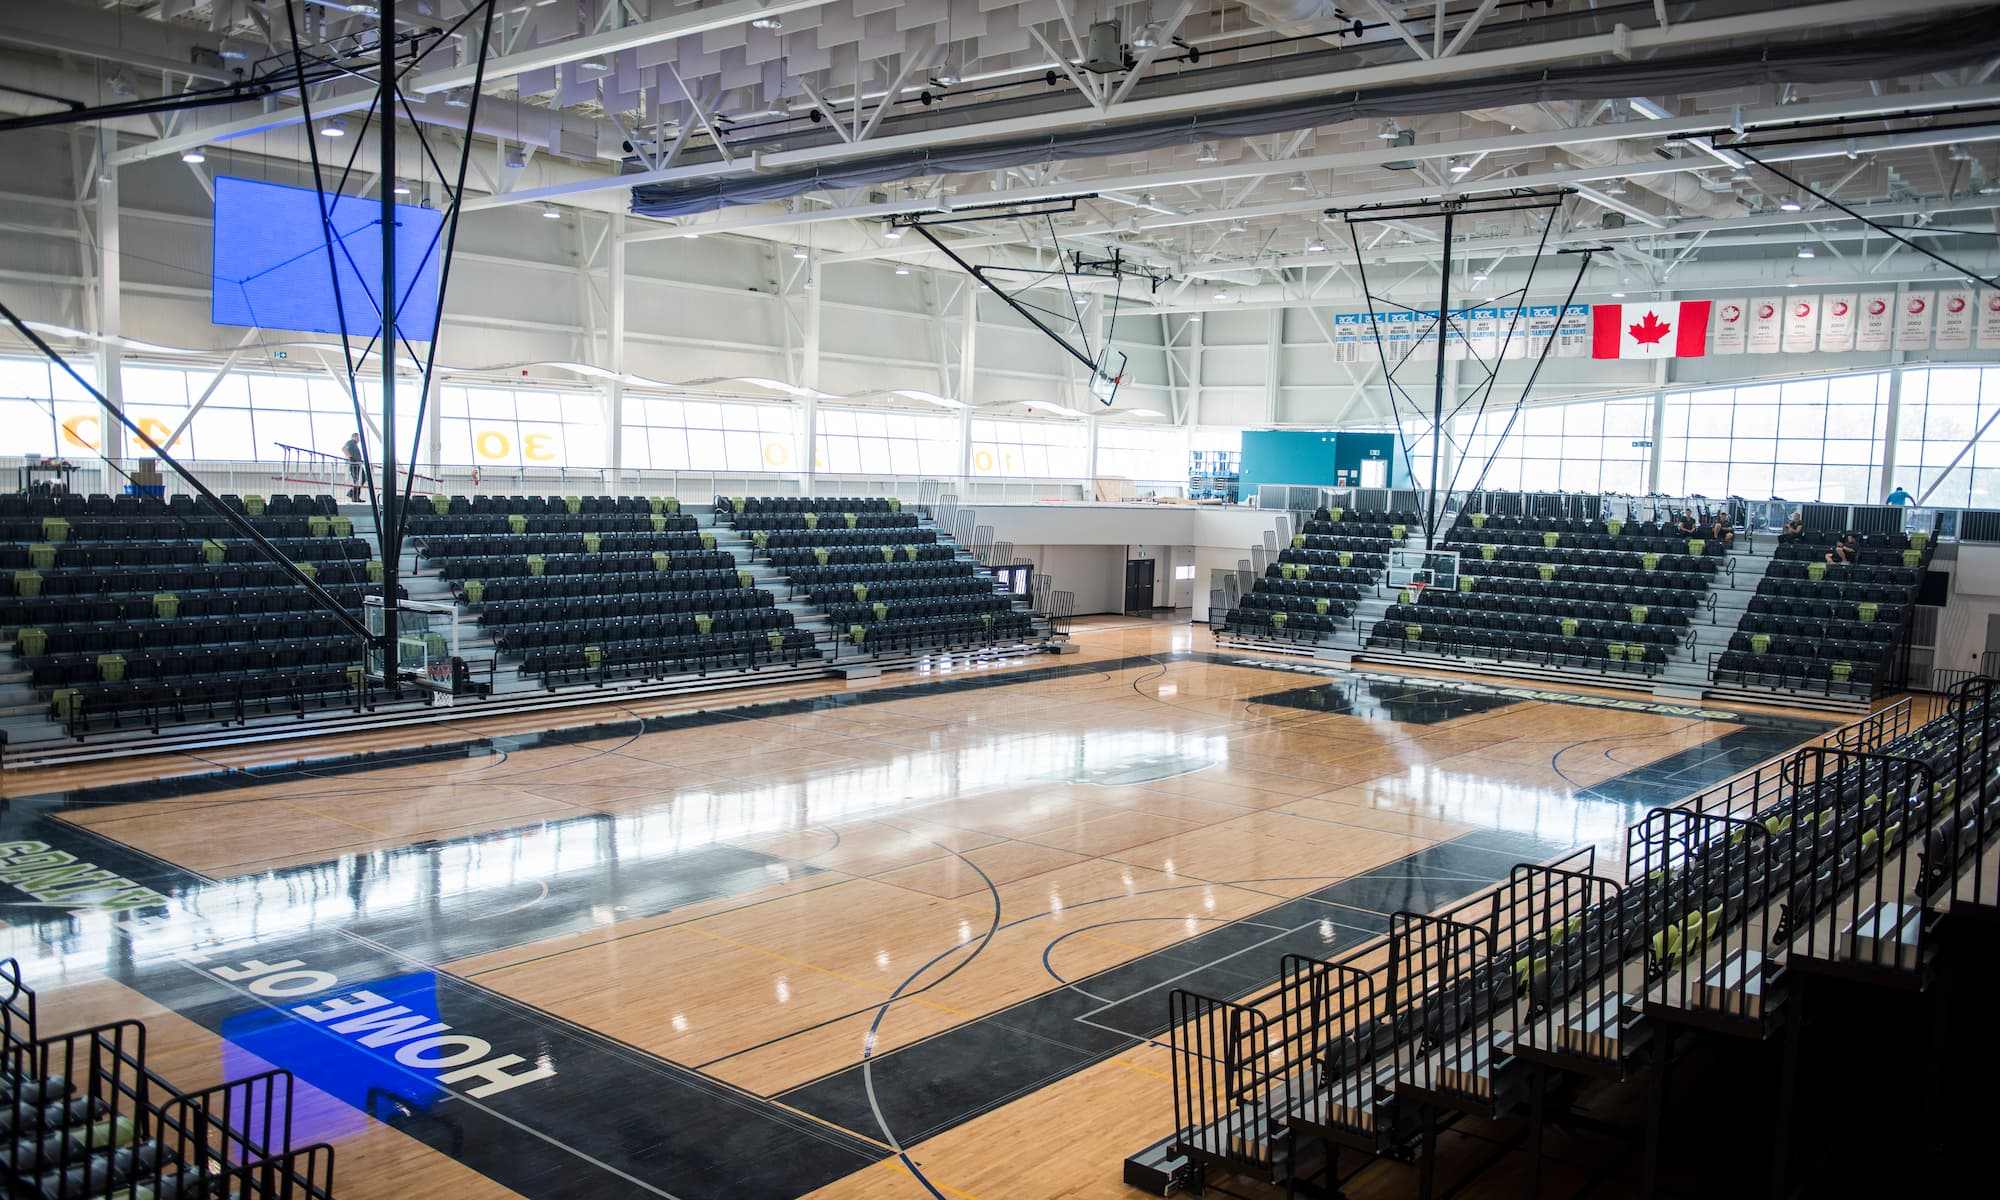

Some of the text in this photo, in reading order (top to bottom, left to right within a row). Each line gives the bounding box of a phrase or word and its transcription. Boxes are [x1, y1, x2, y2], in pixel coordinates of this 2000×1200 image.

[1496, 688, 1738, 719] QUEENS
[209, 959, 558, 1099] HOME OF
